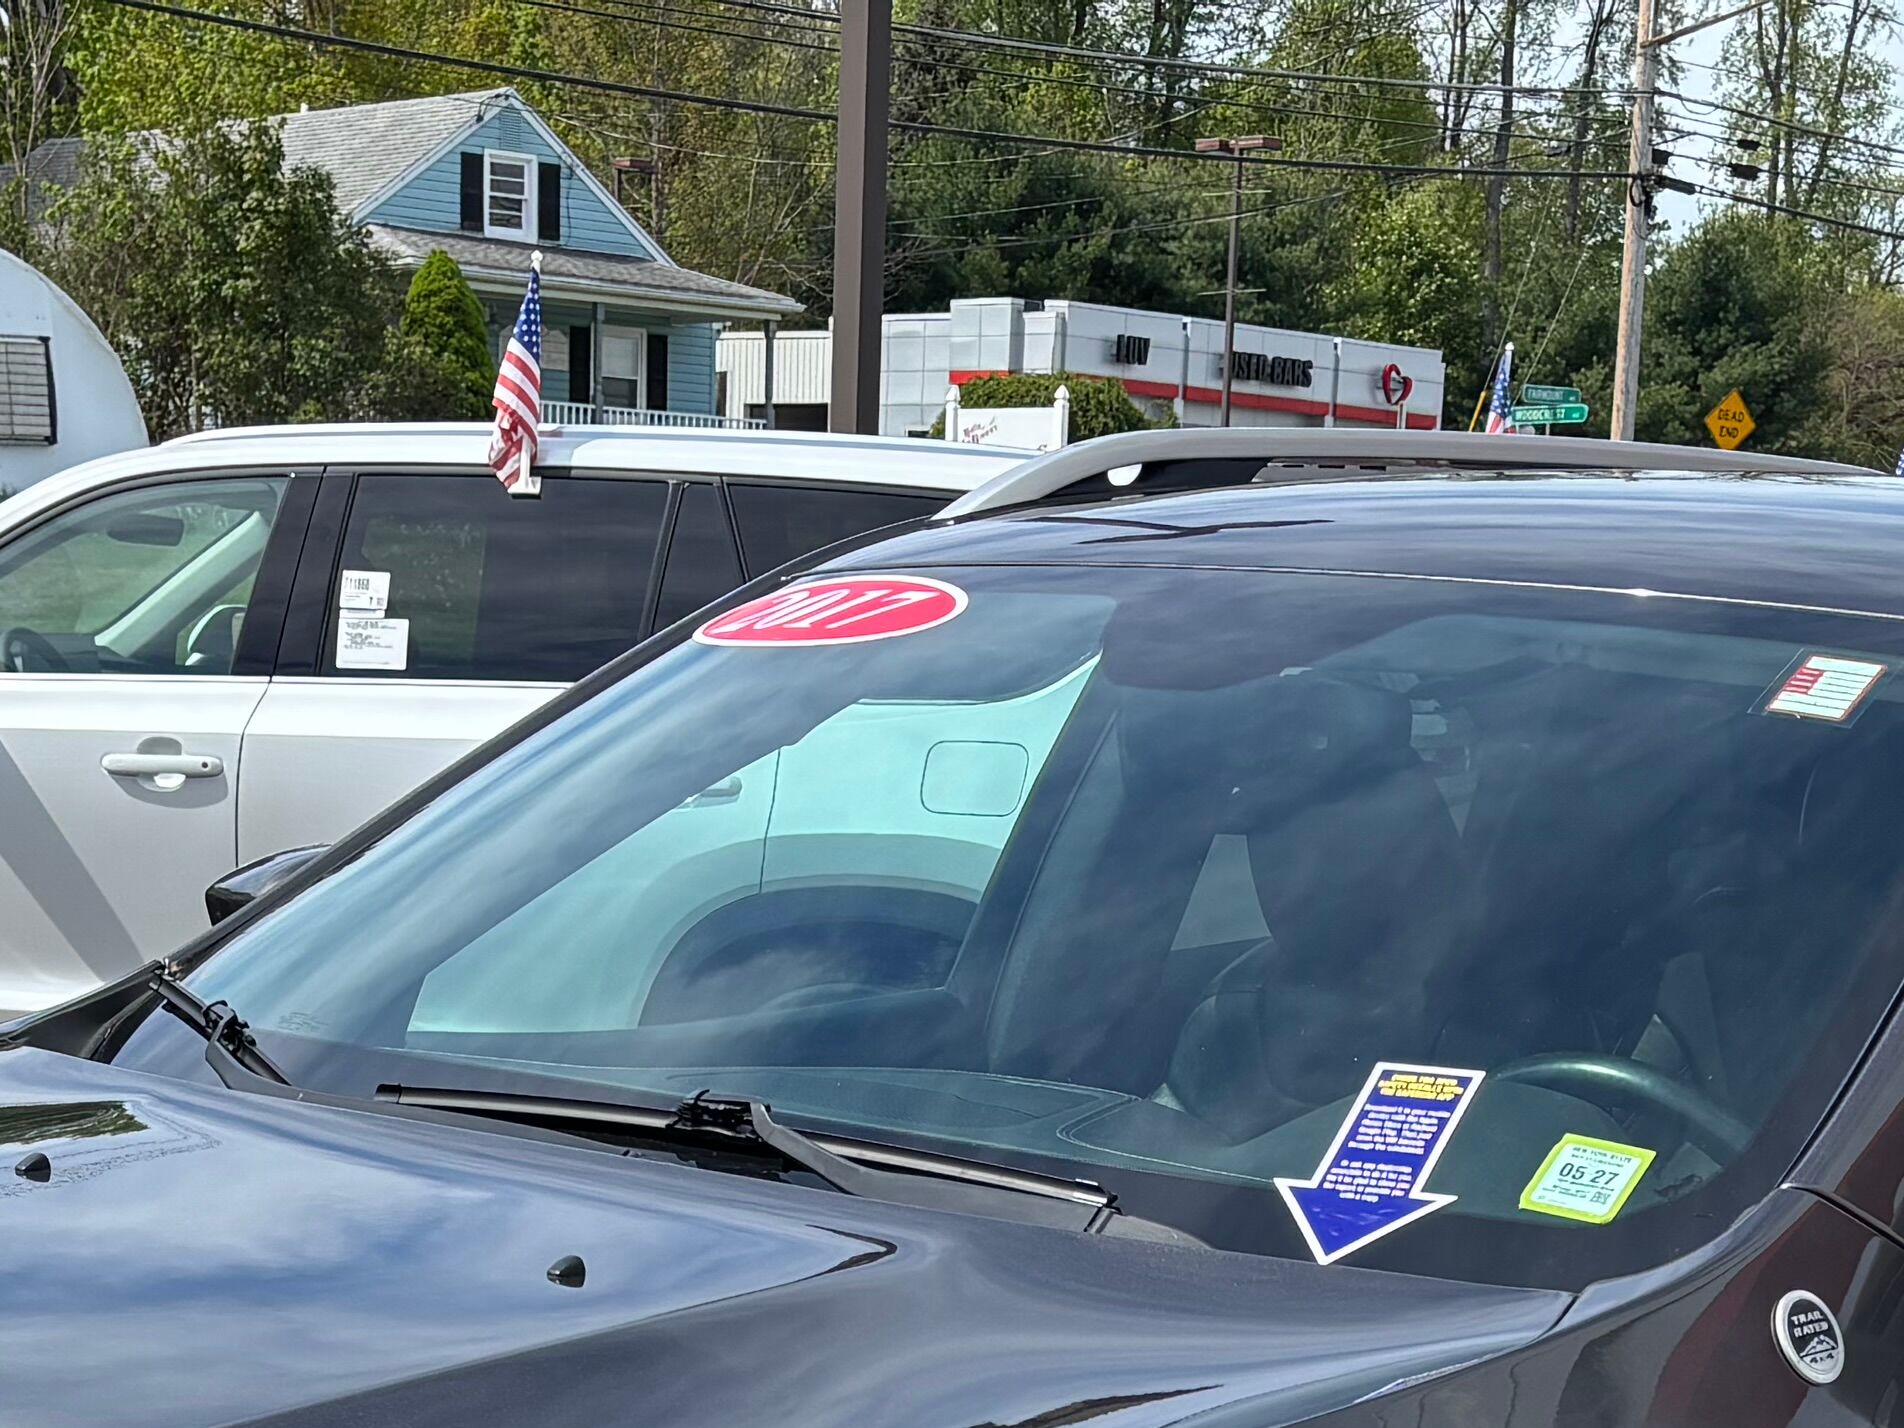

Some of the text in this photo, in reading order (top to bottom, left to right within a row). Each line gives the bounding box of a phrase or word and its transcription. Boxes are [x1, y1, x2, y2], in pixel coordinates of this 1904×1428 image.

[1718, 408, 1745, 423] DEAD
[1719, 425, 1740, 439] END
[708, 588, 941, 635] 2017
[1558, 1162, 1589, 1181] 05
[1589, 1169, 1620, 1186] 27
[1790, 1310, 1824, 1325] TRAIL
[1793, 1321, 1829, 1338] RATED
